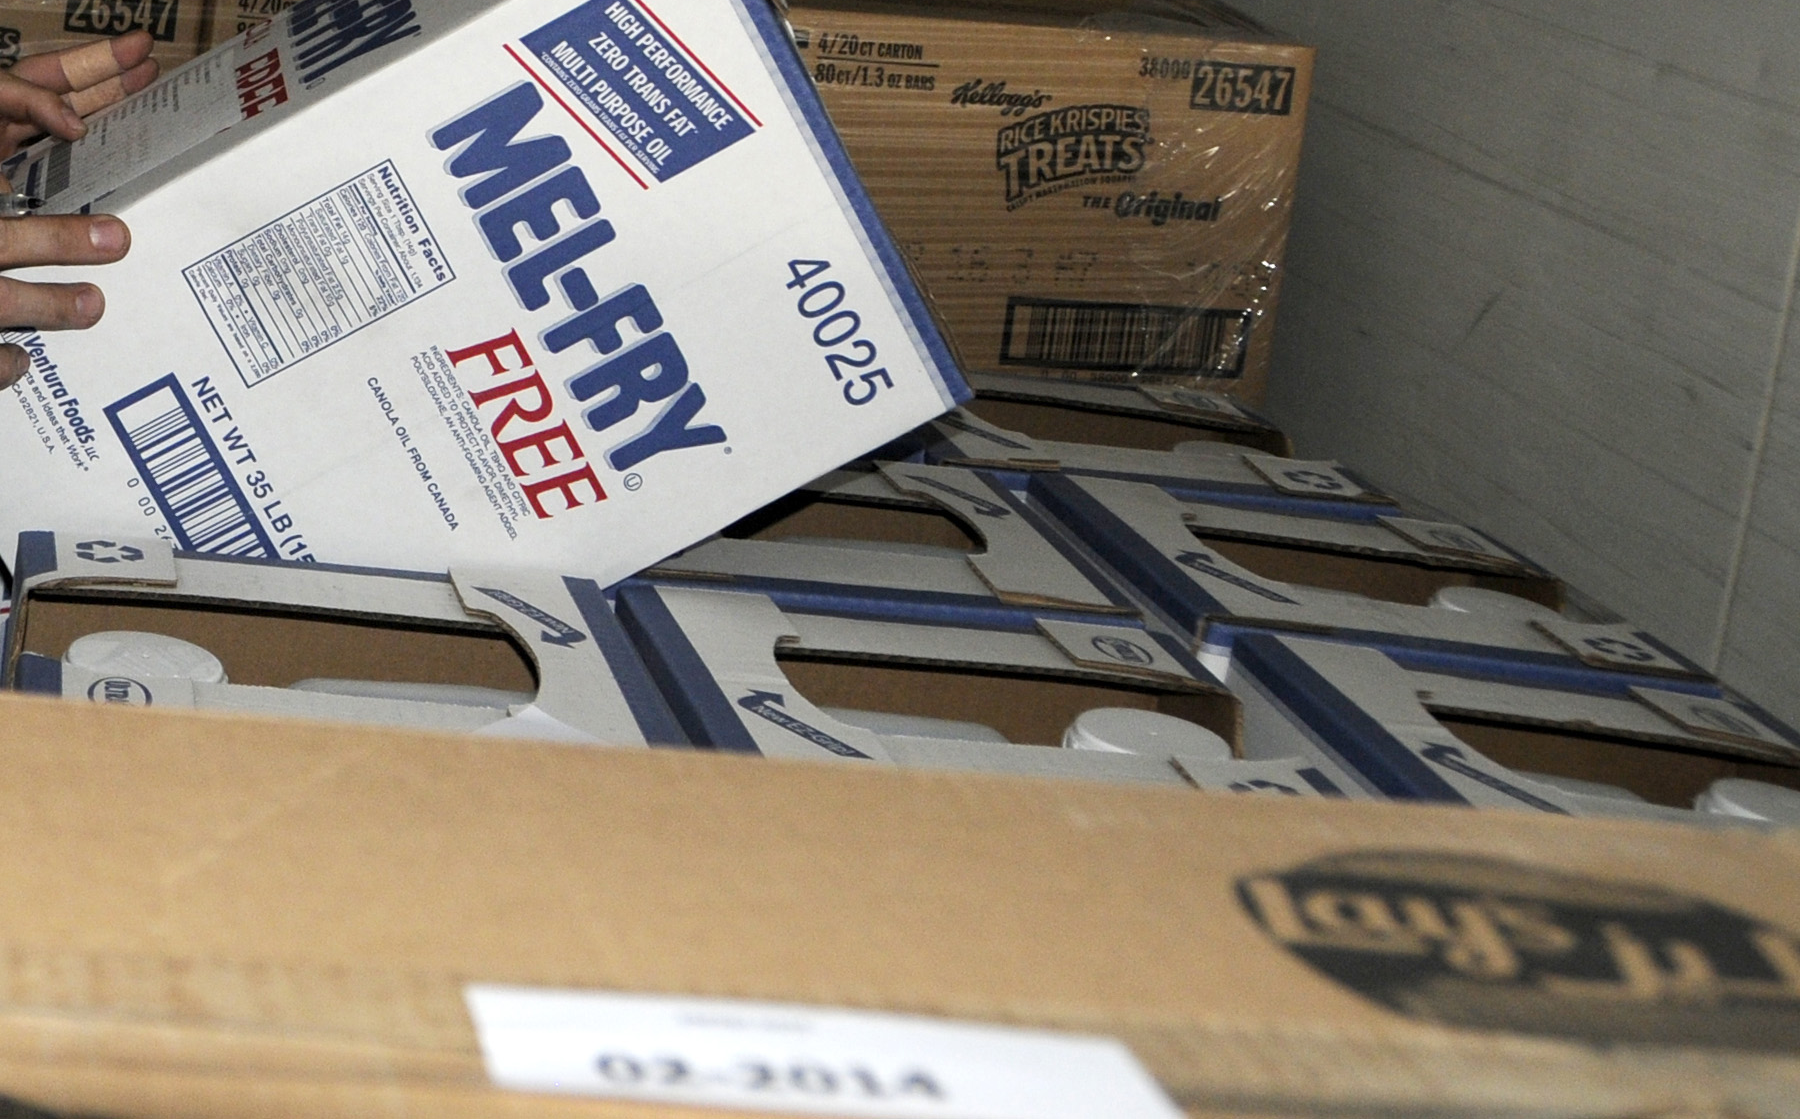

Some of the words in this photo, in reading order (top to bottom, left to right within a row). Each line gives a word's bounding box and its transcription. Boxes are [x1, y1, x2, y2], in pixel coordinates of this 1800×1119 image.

[585, 31, 633, 71] ZERO
[618, 64, 674, 114] TRANS
[601, 0, 647, 40] HIGH
[632, 31, 736, 131] PERFORMANCE
[877, 43, 924, 60] CARTON
[887, 75, 903, 88] OZ
[904, 75, 936, 92] BARS
[1140, 56, 1191, 80] 38000
[1194, 63, 1292, 112] 26547
[547, 40, 600, 86] MULTI
[584, 79, 657, 143] PURPOSE
[641, 137, 678, 166] OIL
[564, 79, 584, 95] ZERO
[578, 92, 603, 114] GRAMS
[596, 111, 620, 131] TRANS
[613, 129, 629, 141] FAT
[623, 139, 639, 152] PER
[633, 150, 661, 174] SERVING
[951, 78, 1046, 116] Kellogg's
[1001, 115, 1048, 155] RICE
[1050, 106, 1150, 133] KRISPIES
[365, 172, 386, 199] Serving
[381, 197, 394, 214] Size
[1001, 133, 1145, 201] TREATS
[304, 212, 321, 234] Trans
[316, 233, 328, 247] Fat
[313, 207, 338, 242] Saturated
[332, 241, 345, 254] Fat
[321, 197, 336, 216] Total
[332, 216, 344, 230] Fat
[338, 230, 352, 245] 14g
[338, 187, 359, 217] Calories
[355, 217, 367, 231] 120
[363, 232, 383, 260] Calories
[378, 259, 393, 278] From
[388, 277, 399, 290] Fat
[376, 165, 423, 234] Nutrition
[416, 236, 450, 282] Facts
[1083, 195, 1110, 210] THE
[1114, 190, 1223, 226] Original
[223, 249, 243, 276] Protein
[234, 248, 254, 274] Sugars
[244, 243, 265, 269] Dietary
[260, 268, 275, 287] Fiber
[253, 233, 269, 253] Total
[261, 252, 298, 307] Carbohydrates
[262, 228, 283, 257] Sodium
[272, 223, 300, 265] Cholesterol
[284, 223, 323, 281] Monounsaturated
[316, 279, 329, 294] Fat
[292, 217, 330, 272] Polyunsaturated
[324, 270, 336, 284] Fat
[397, 249, 413, 270] About
[426, 79, 728, 472] MEL-FRY
[203, 260, 224, 288] Calcium
[239, 323, 252, 338] Iron
[212, 255, 231, 281] Vitamin
[246, 316, 265, 342] Vitamin
[786, 258, 895, 406] 40025
[10, 381, 24, 397] CA
[35, 425, 56, 455] U.S.A.
[23, 334, 68, 401] Ventura
[58, 395, 98, 449] Foods,
[84, 445, 99, 463] LLC
[32, 384, 47, 402] and
[41, 401, 60, 427] Ideas
[55, 425, 71, 445] that
[419, 350, 436, 371] ACID
[430, 369, 452, 400] ADDED
[447, 398, 458, 412] TO
[453, 409, 479, 449] PROTECT
[429, 343, 466, 403] INGREDIENTS:
[460, 399, 484, 435] CANOLA
[488, 449, 506, 474] TBHQ
[501, 472, 516, 491] AND
[510, 488, 530, 518] CITRIC
[445, 327, 608, 521] FREE
[190, 374, 233, 428] NET
[219, 425, 257, 470] WT
[243, 468, 274, 501] 35
[262, 499, 294, 535] LB
[364, 375, 400, 425] CANOLA
[393, 425, 413, 447] OIL
[405, 446, 432, 483] FROM
[425, 481, 460, 531] CANADA
[443, 414, 455, 428] AN
[450, 426, 487, 485] ANTI-FOAMING
[482, 482, 502, 512] AGENT
[125, 476, 140, 489] 0
[136, 494, 157, 517] 00
[752, 704, 790, 728] New
